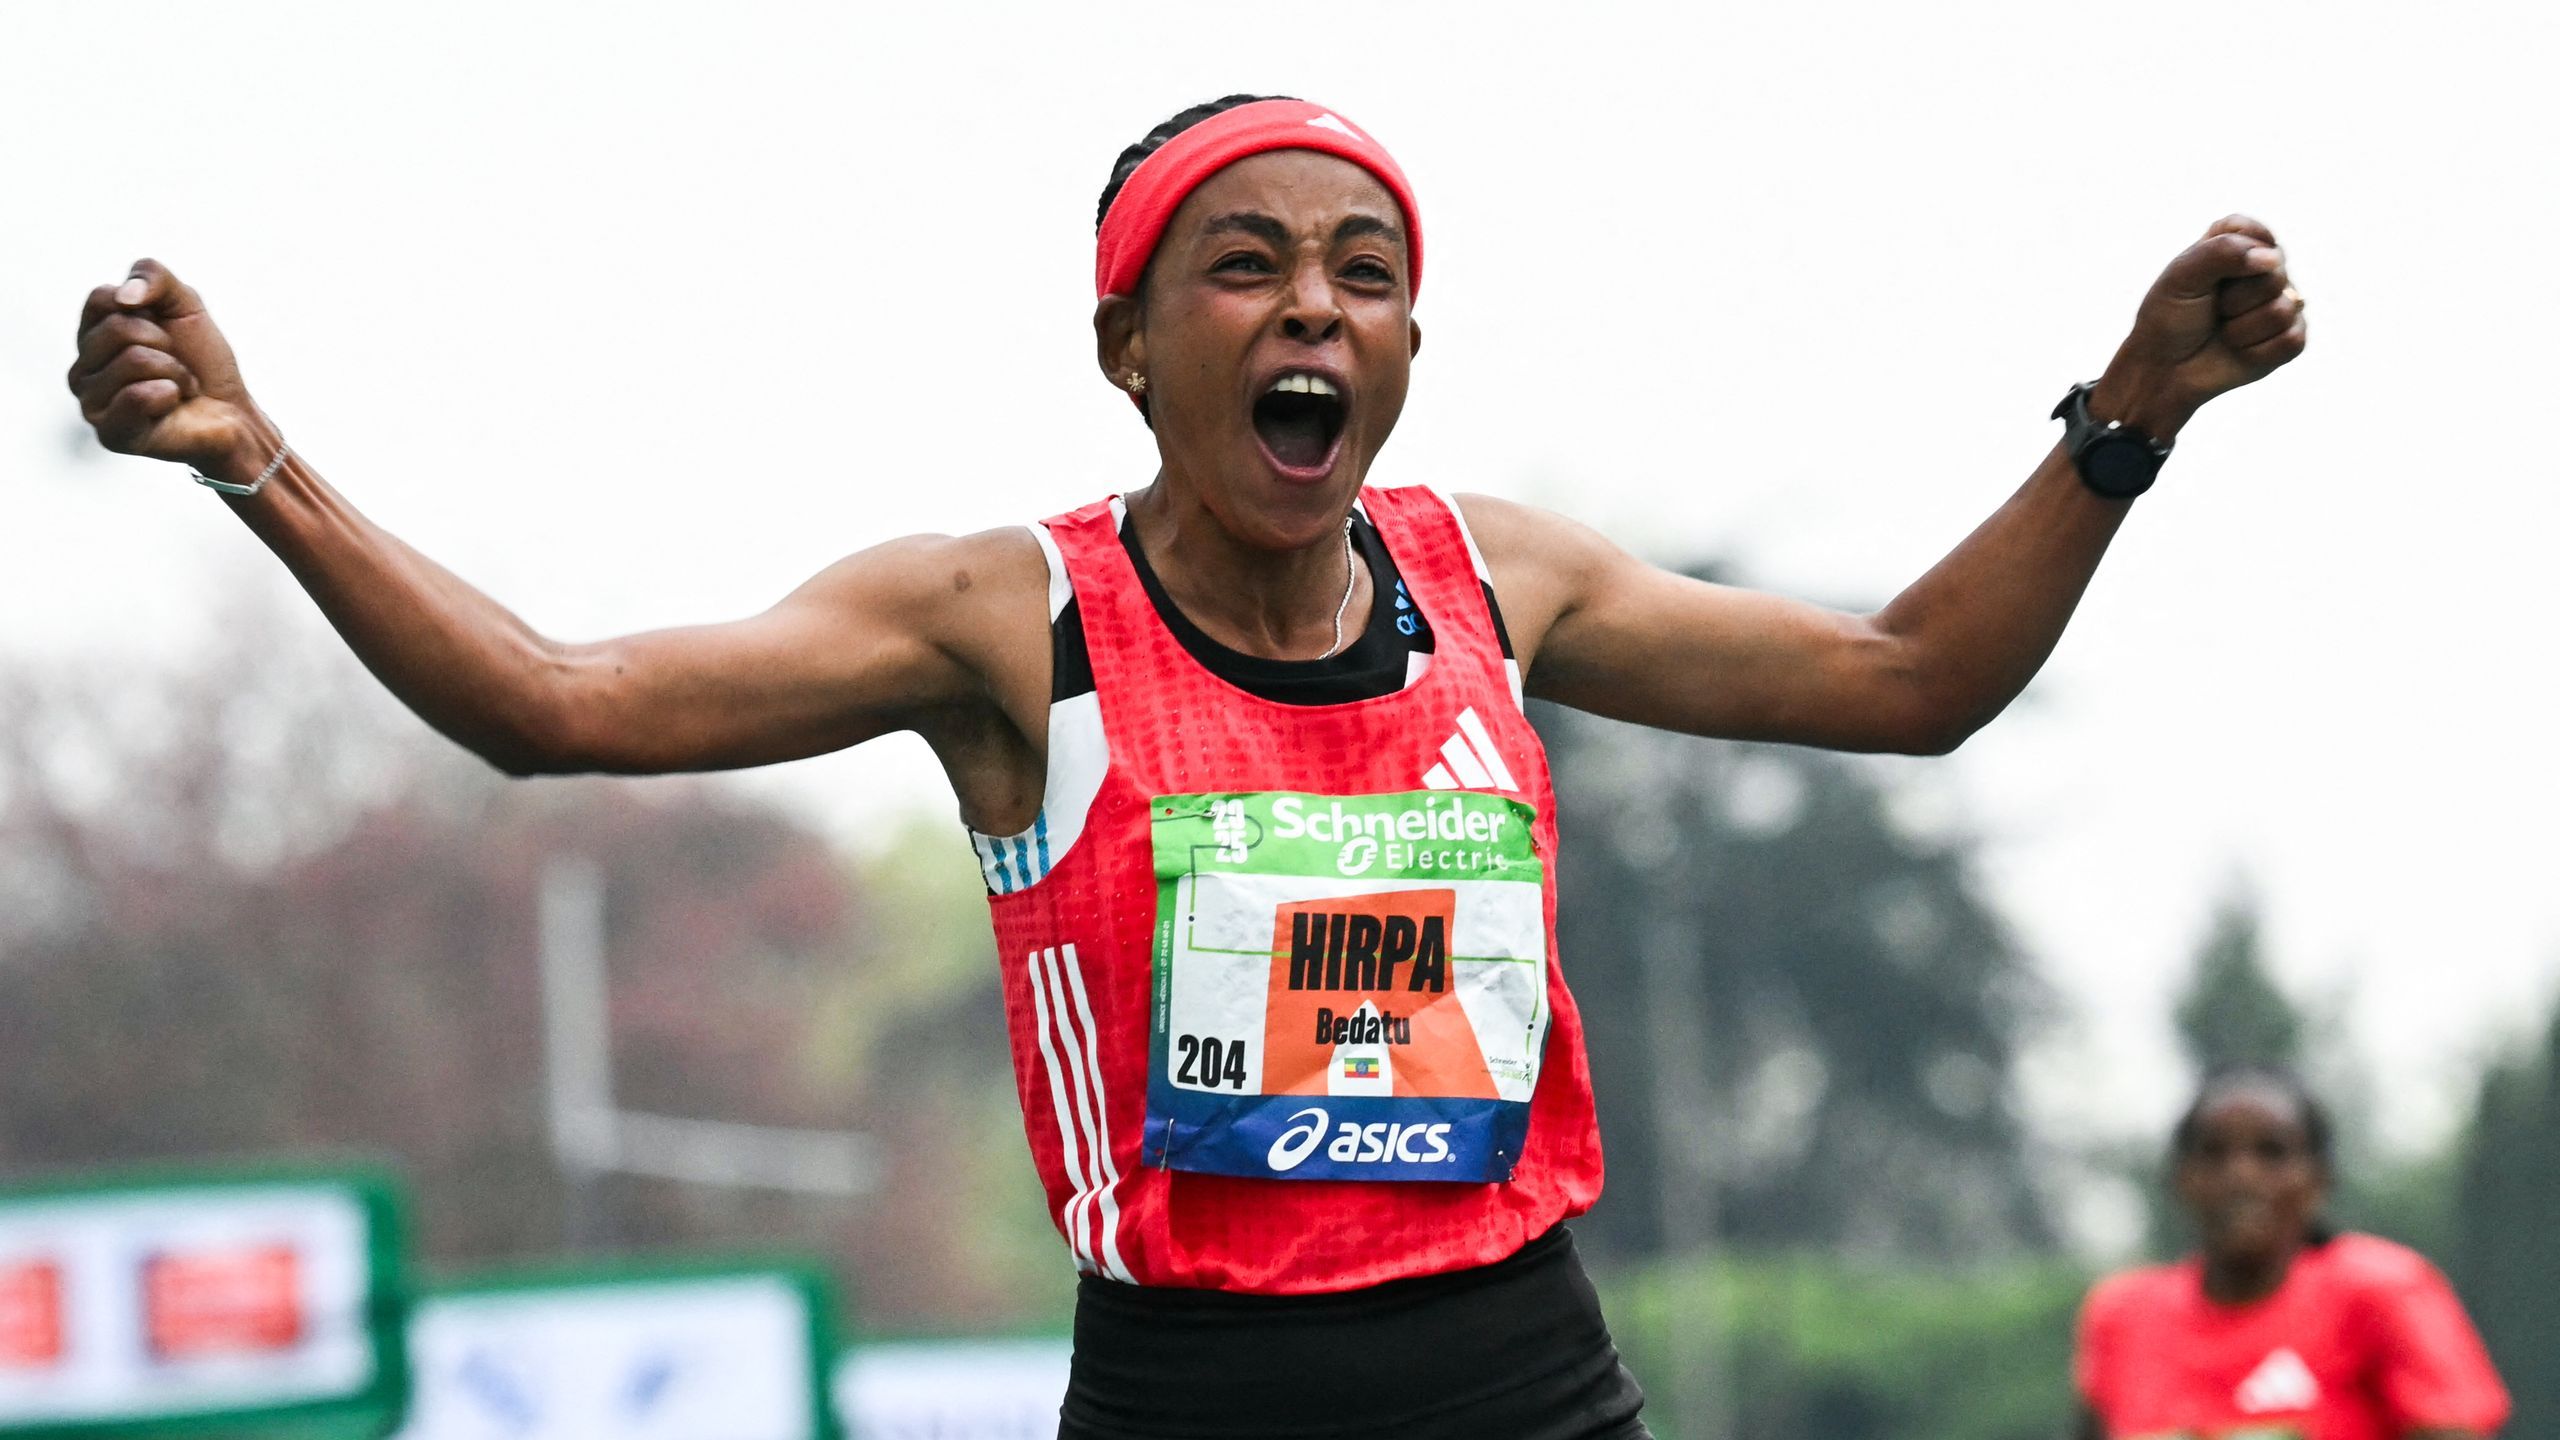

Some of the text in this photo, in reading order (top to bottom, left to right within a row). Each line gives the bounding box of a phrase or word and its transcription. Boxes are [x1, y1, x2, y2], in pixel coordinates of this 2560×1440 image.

[1271, 797, 1506, 842] Schneider
[1214, 830, 1248, 864] 25
[1385, 844, 1508, 870] Electric
[1288, 912, 1445, 993] HIRPA
[1315, 1008, 1410, 1045] Bedatu
[1177, 1034, 1246, 1090] 204
